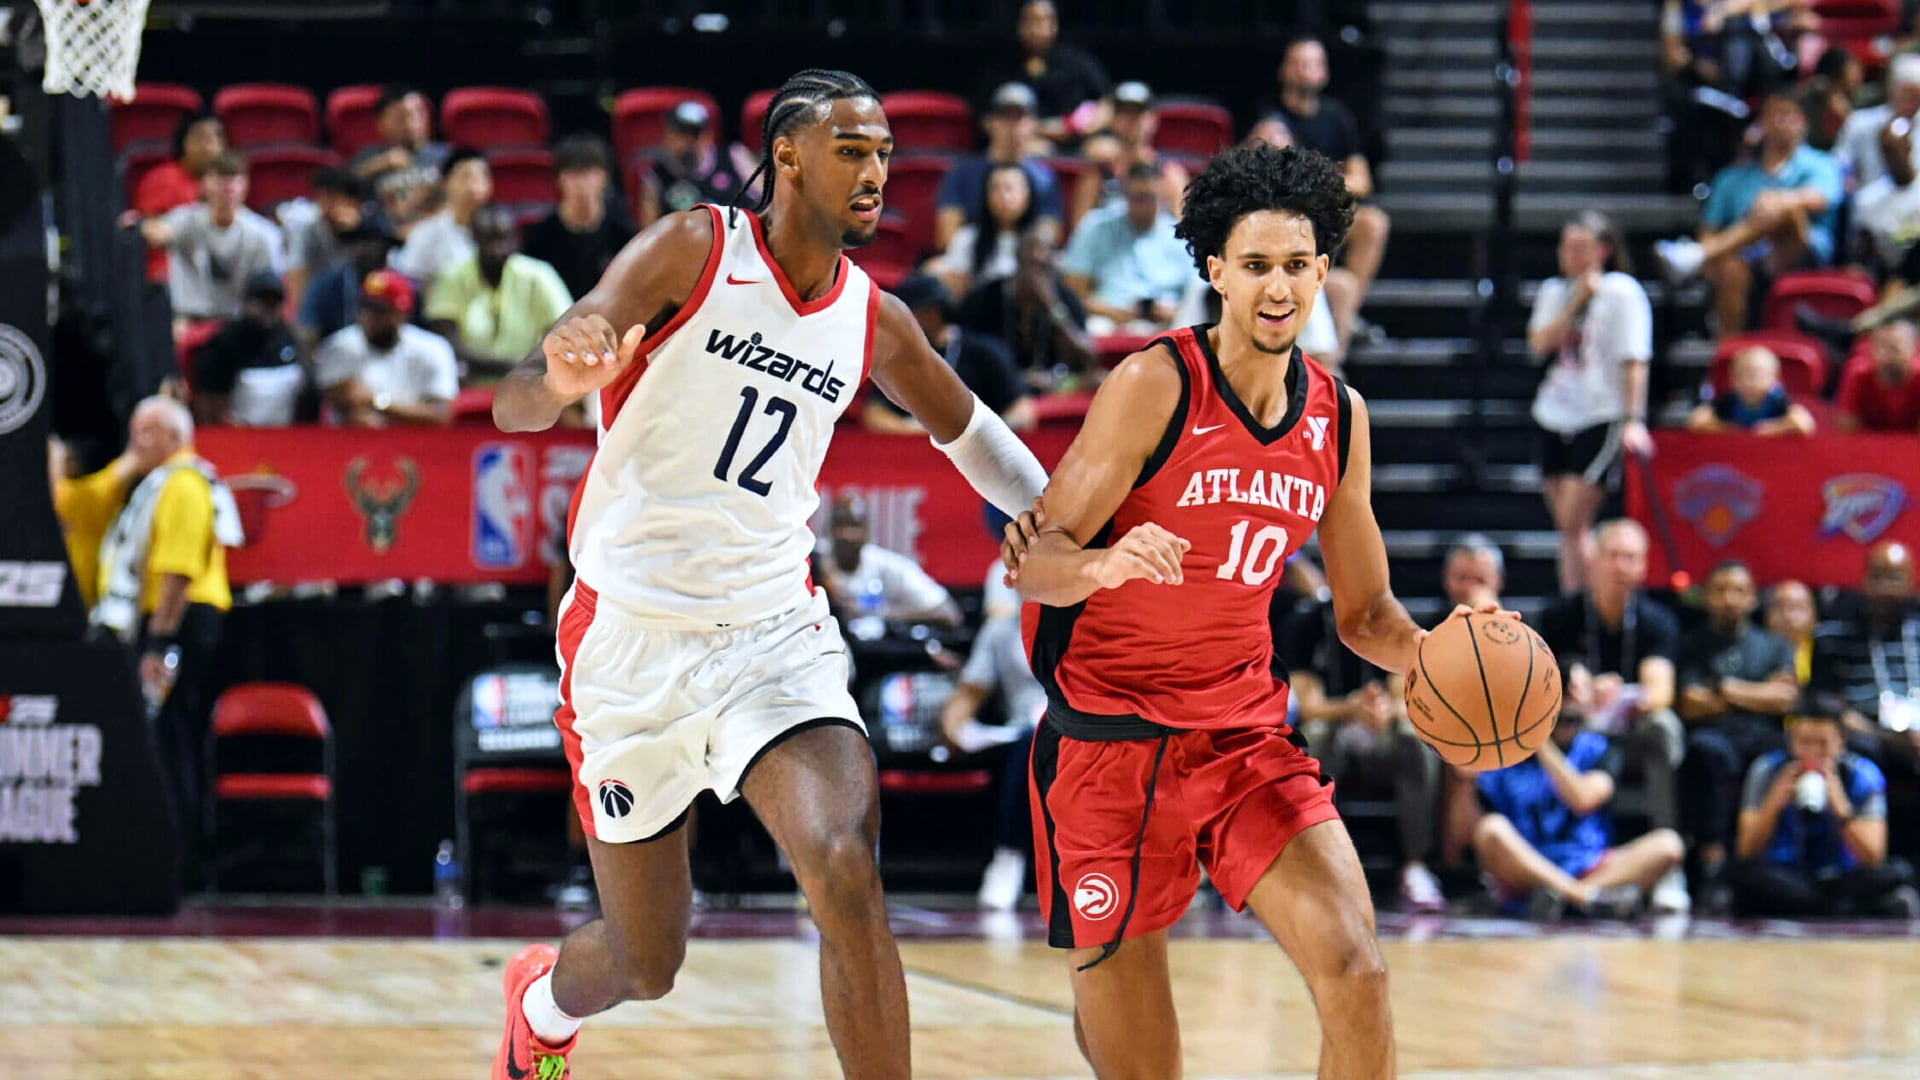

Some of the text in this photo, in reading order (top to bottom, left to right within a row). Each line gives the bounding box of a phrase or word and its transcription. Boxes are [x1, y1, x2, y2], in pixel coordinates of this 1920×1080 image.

[705, 328, 847, 404] wizards
[713, 385, 798, 498] 12
[1176, 468, 1326, 522] ATLANTA
[1216, 520, 1289, 586] 10
